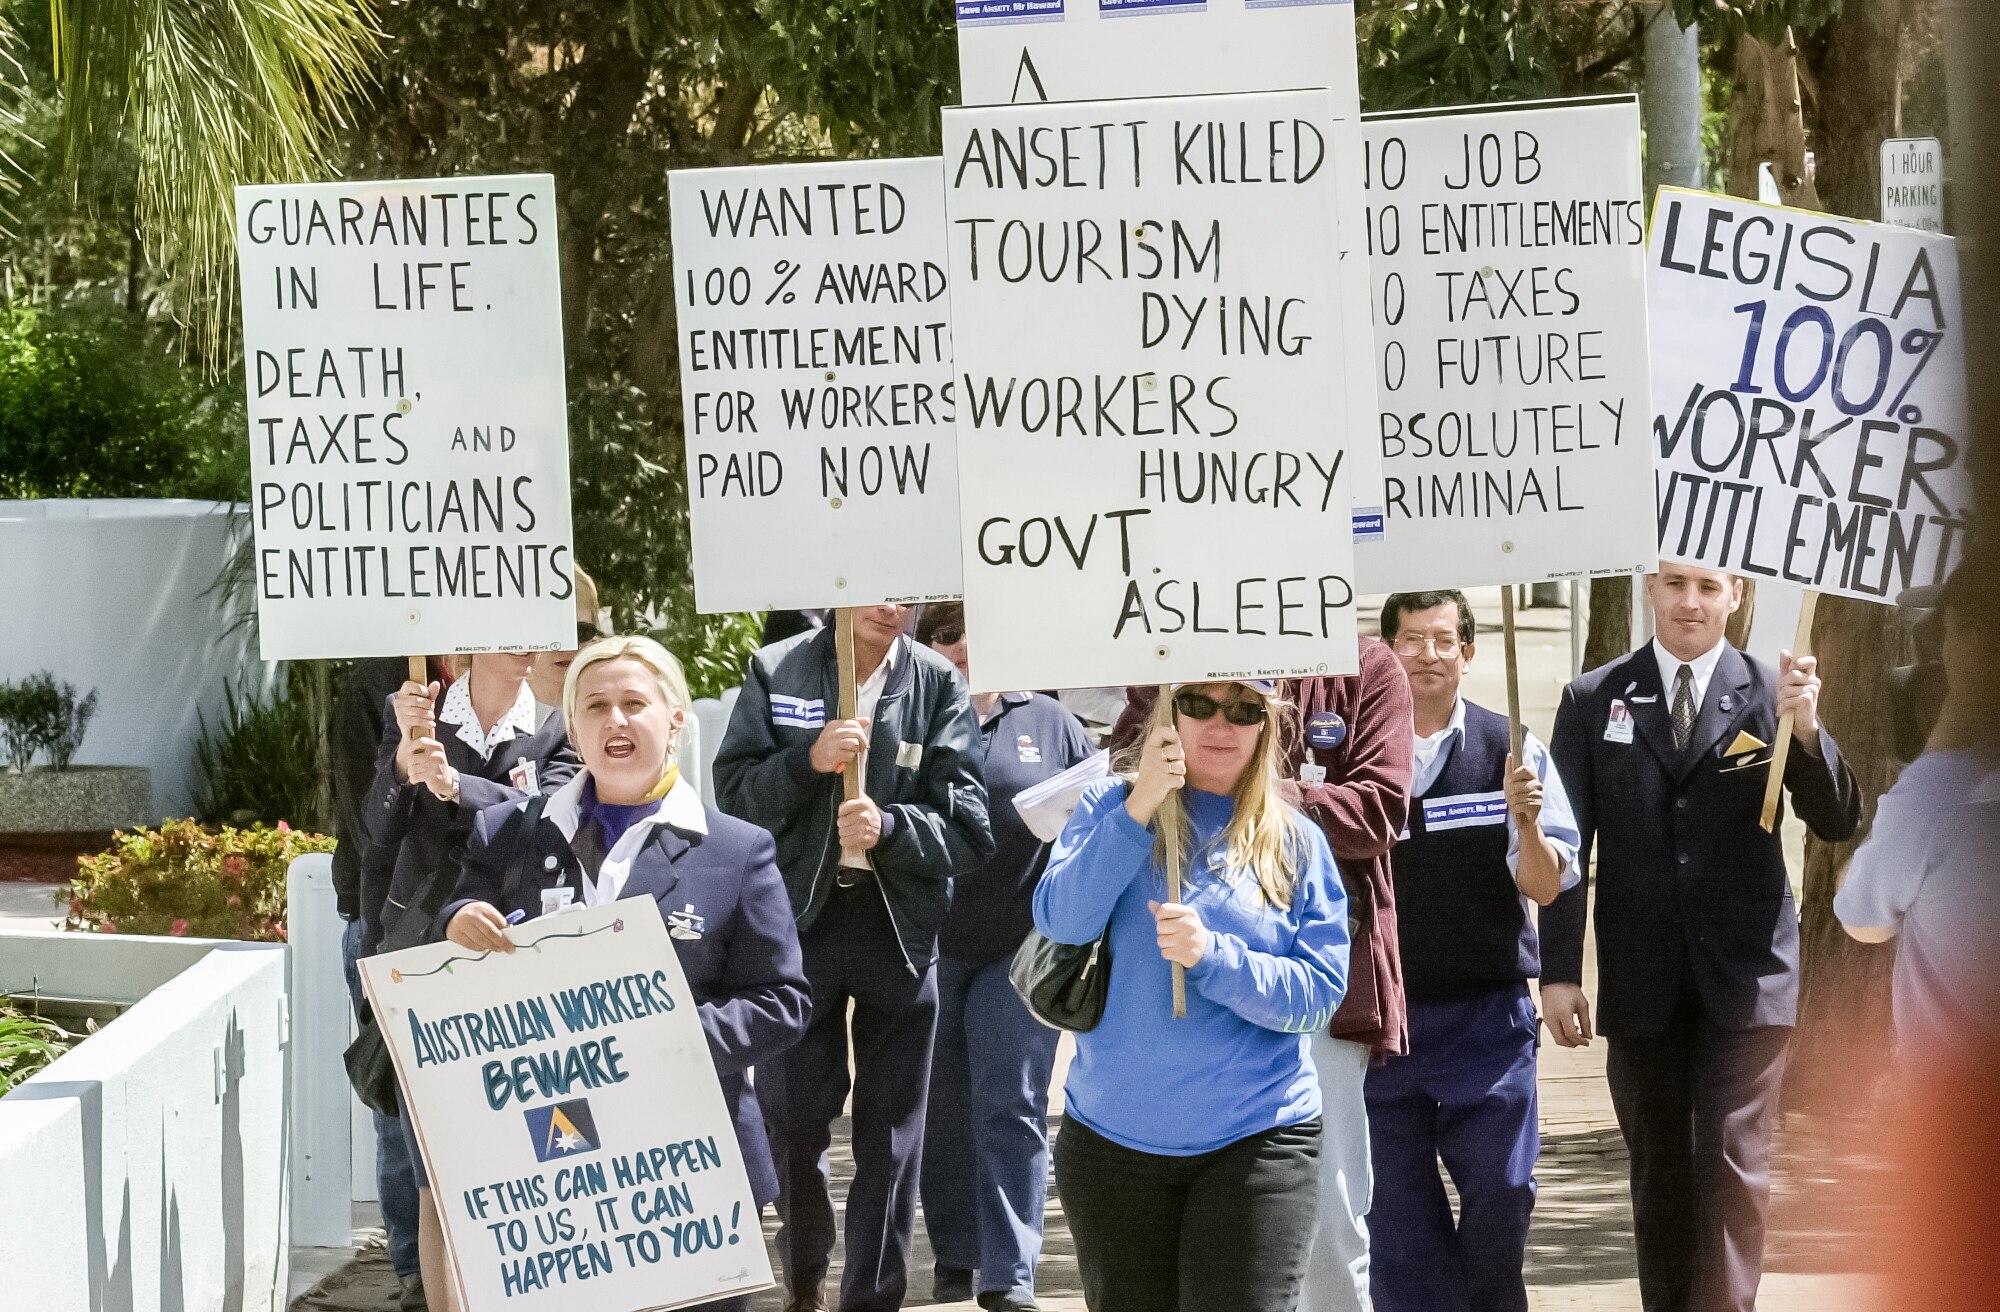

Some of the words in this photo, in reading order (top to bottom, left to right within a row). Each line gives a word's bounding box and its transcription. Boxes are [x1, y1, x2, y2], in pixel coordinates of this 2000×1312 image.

[1013, 2, 1026, 11] Mr
[1027, 1, 1061, 10] Howard
[955, 121, 1148, 190] ANSETT
[1174, 119, 1325, 186] KILLED
[1364, 137, 1407, 190] O
[1445, 131, 1542, 190] JOB
[1891, 154, 1896, 175] 1
[1902, 152, 1934, 174] HOUR
[247, 192, 538, 247] GUARANTEES
[700, 183, 905, 238] WANTED
[1887, 187, 1937, 208] PARKING
[954, 219, 1220, 283] TOURISM
[1366, 205, 1400, 256] O
[1422, 200, 1643, 255] ENTITLEMENTS
[275, 266, 318, 310] IN
[373, 262, 491, 311] LIFE.
[688, 267, 751, 307] 100
[815, 262, 947, 305] AWARD
[1436, 267, 1580, 323] TAXES
[691, 323, 953, 371] ENTITLEMENT
[1142, 292, 1312, 356] DYING
[256, 347, 421, 401] DEATH,
[1384, 341, 1405, 391] O
[1438, 331, 1606, 389] FUTURE
[1730, 299, 1945, 424] 100%
[695, 391, 758, 435] FOR
[964, 372, 1238, 437] WORKERS
[1381, 398, 1624, 458] BSOLUTELY
[258, 413, 409, 465] TAXES
[451, 426, 516, 453] AND
[1653, 383, 1968, 520] WORKER
[699, 451, 783, 498] PAID
[821, 443, 931, 498] NOW
[1140, 449, 1344, 511] HUNGRY
[1385, 466, 1585, 519] RIMINAL
[261, 476, 536, 533] POLITICIANS
[1352, 519, 1381, 529] oward
[978, 509, 1161, 576] GOVT.
[262, 545, 573, 600] ENTITLEMENTS
[1113, 576, 1353, 639] ASLEEP
[408, 997, 556, 1069] AUSTRALIAN
[550, 970, 676, 1034] WORKERS
[482, 1035, 630, 1111] BEWARE
[464, 1187, 489, 1220] IF
[489, 1174, 549, 1215] THIS
[554, 1162, 608, 1202] CAN
[612, 1135, 722, 1189] HAPPEN
[486, 1219, 528, 1256] TO
[595, 1197, 619, 1233] IT
[632, 1182, 694, 1225] CAN
[501, 1241, 613, 1298] HAPPEN
[615, 1230, 660, 1267] TO
[661, 1201, 741, 1258] YOU!
